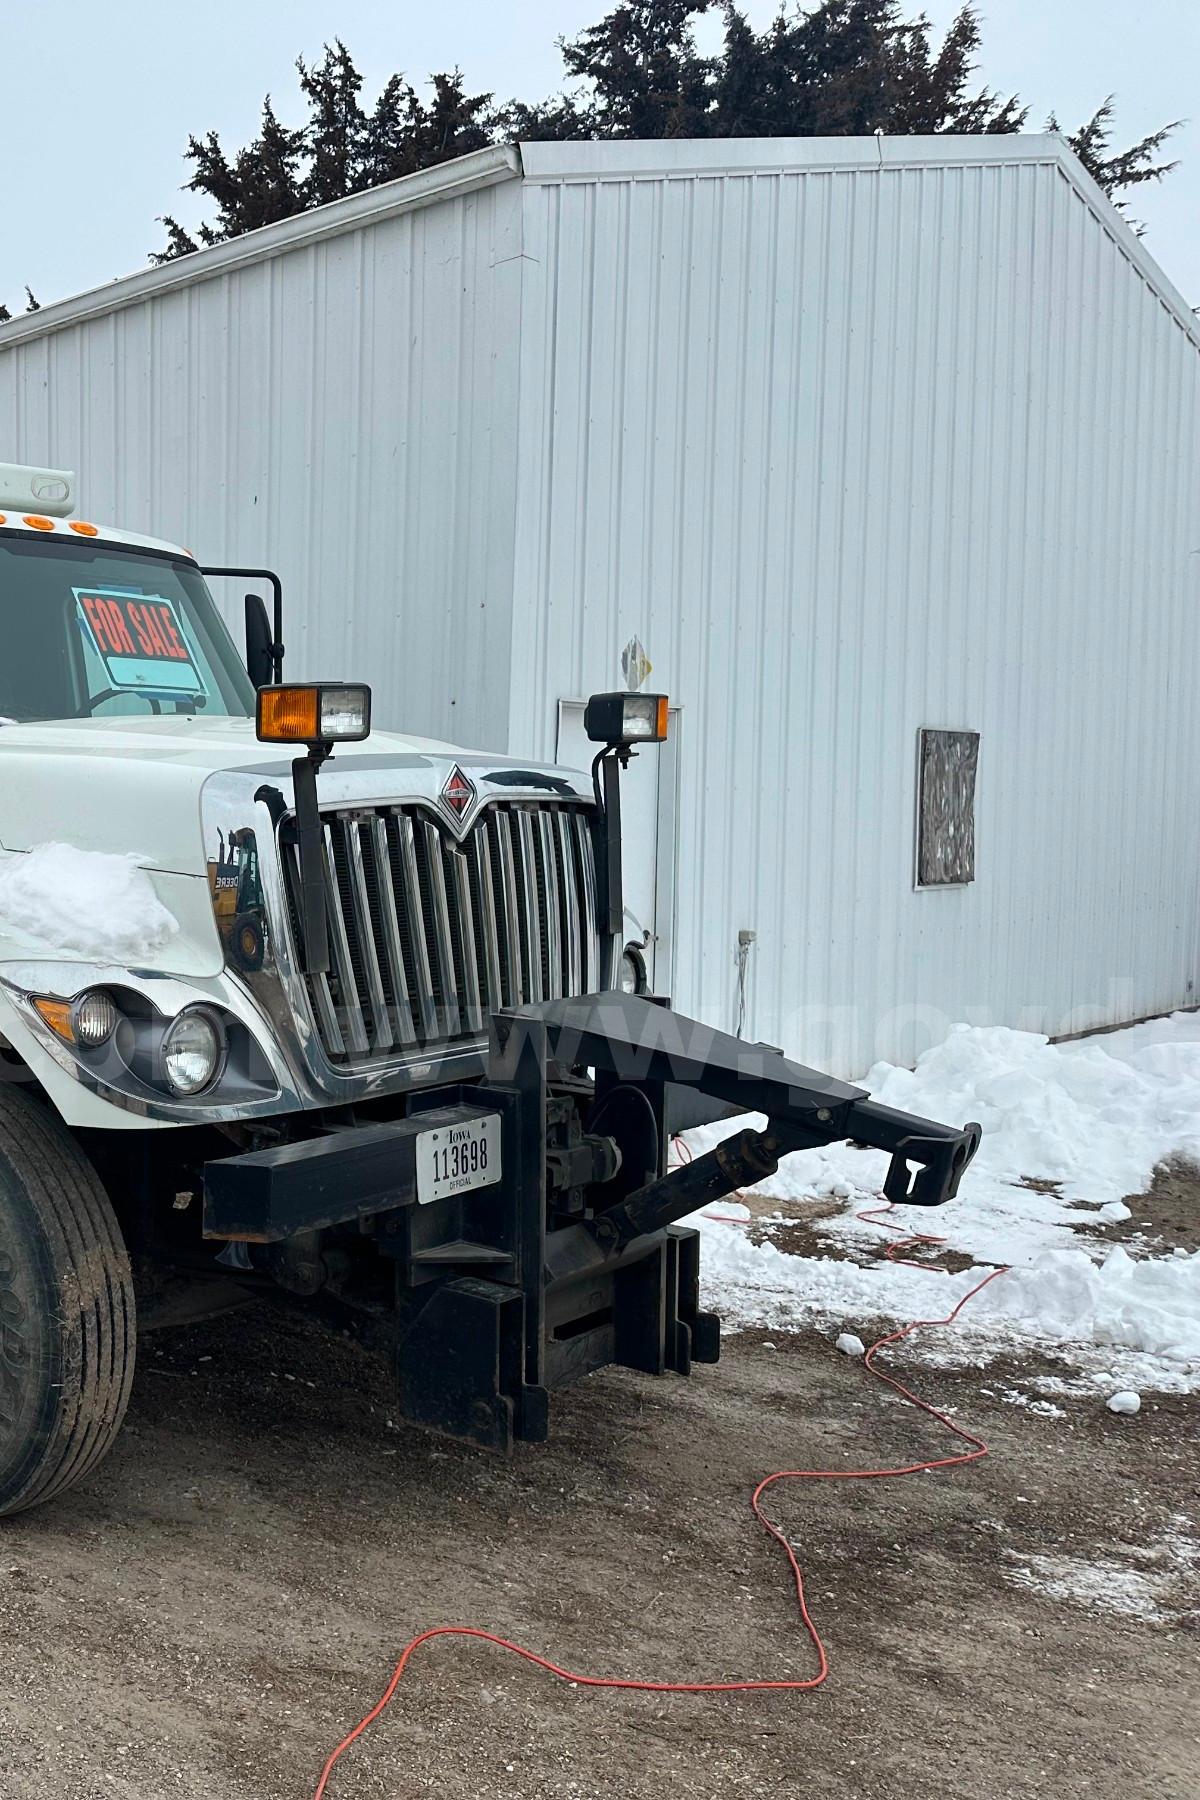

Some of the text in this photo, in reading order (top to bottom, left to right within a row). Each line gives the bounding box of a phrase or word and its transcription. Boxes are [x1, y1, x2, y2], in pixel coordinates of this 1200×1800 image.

[81, 598, 188, 659] FOR SALE
[433, 1138, 488, 1182] 113698
[449, 1177, 472, 1190] OFFICIAL
